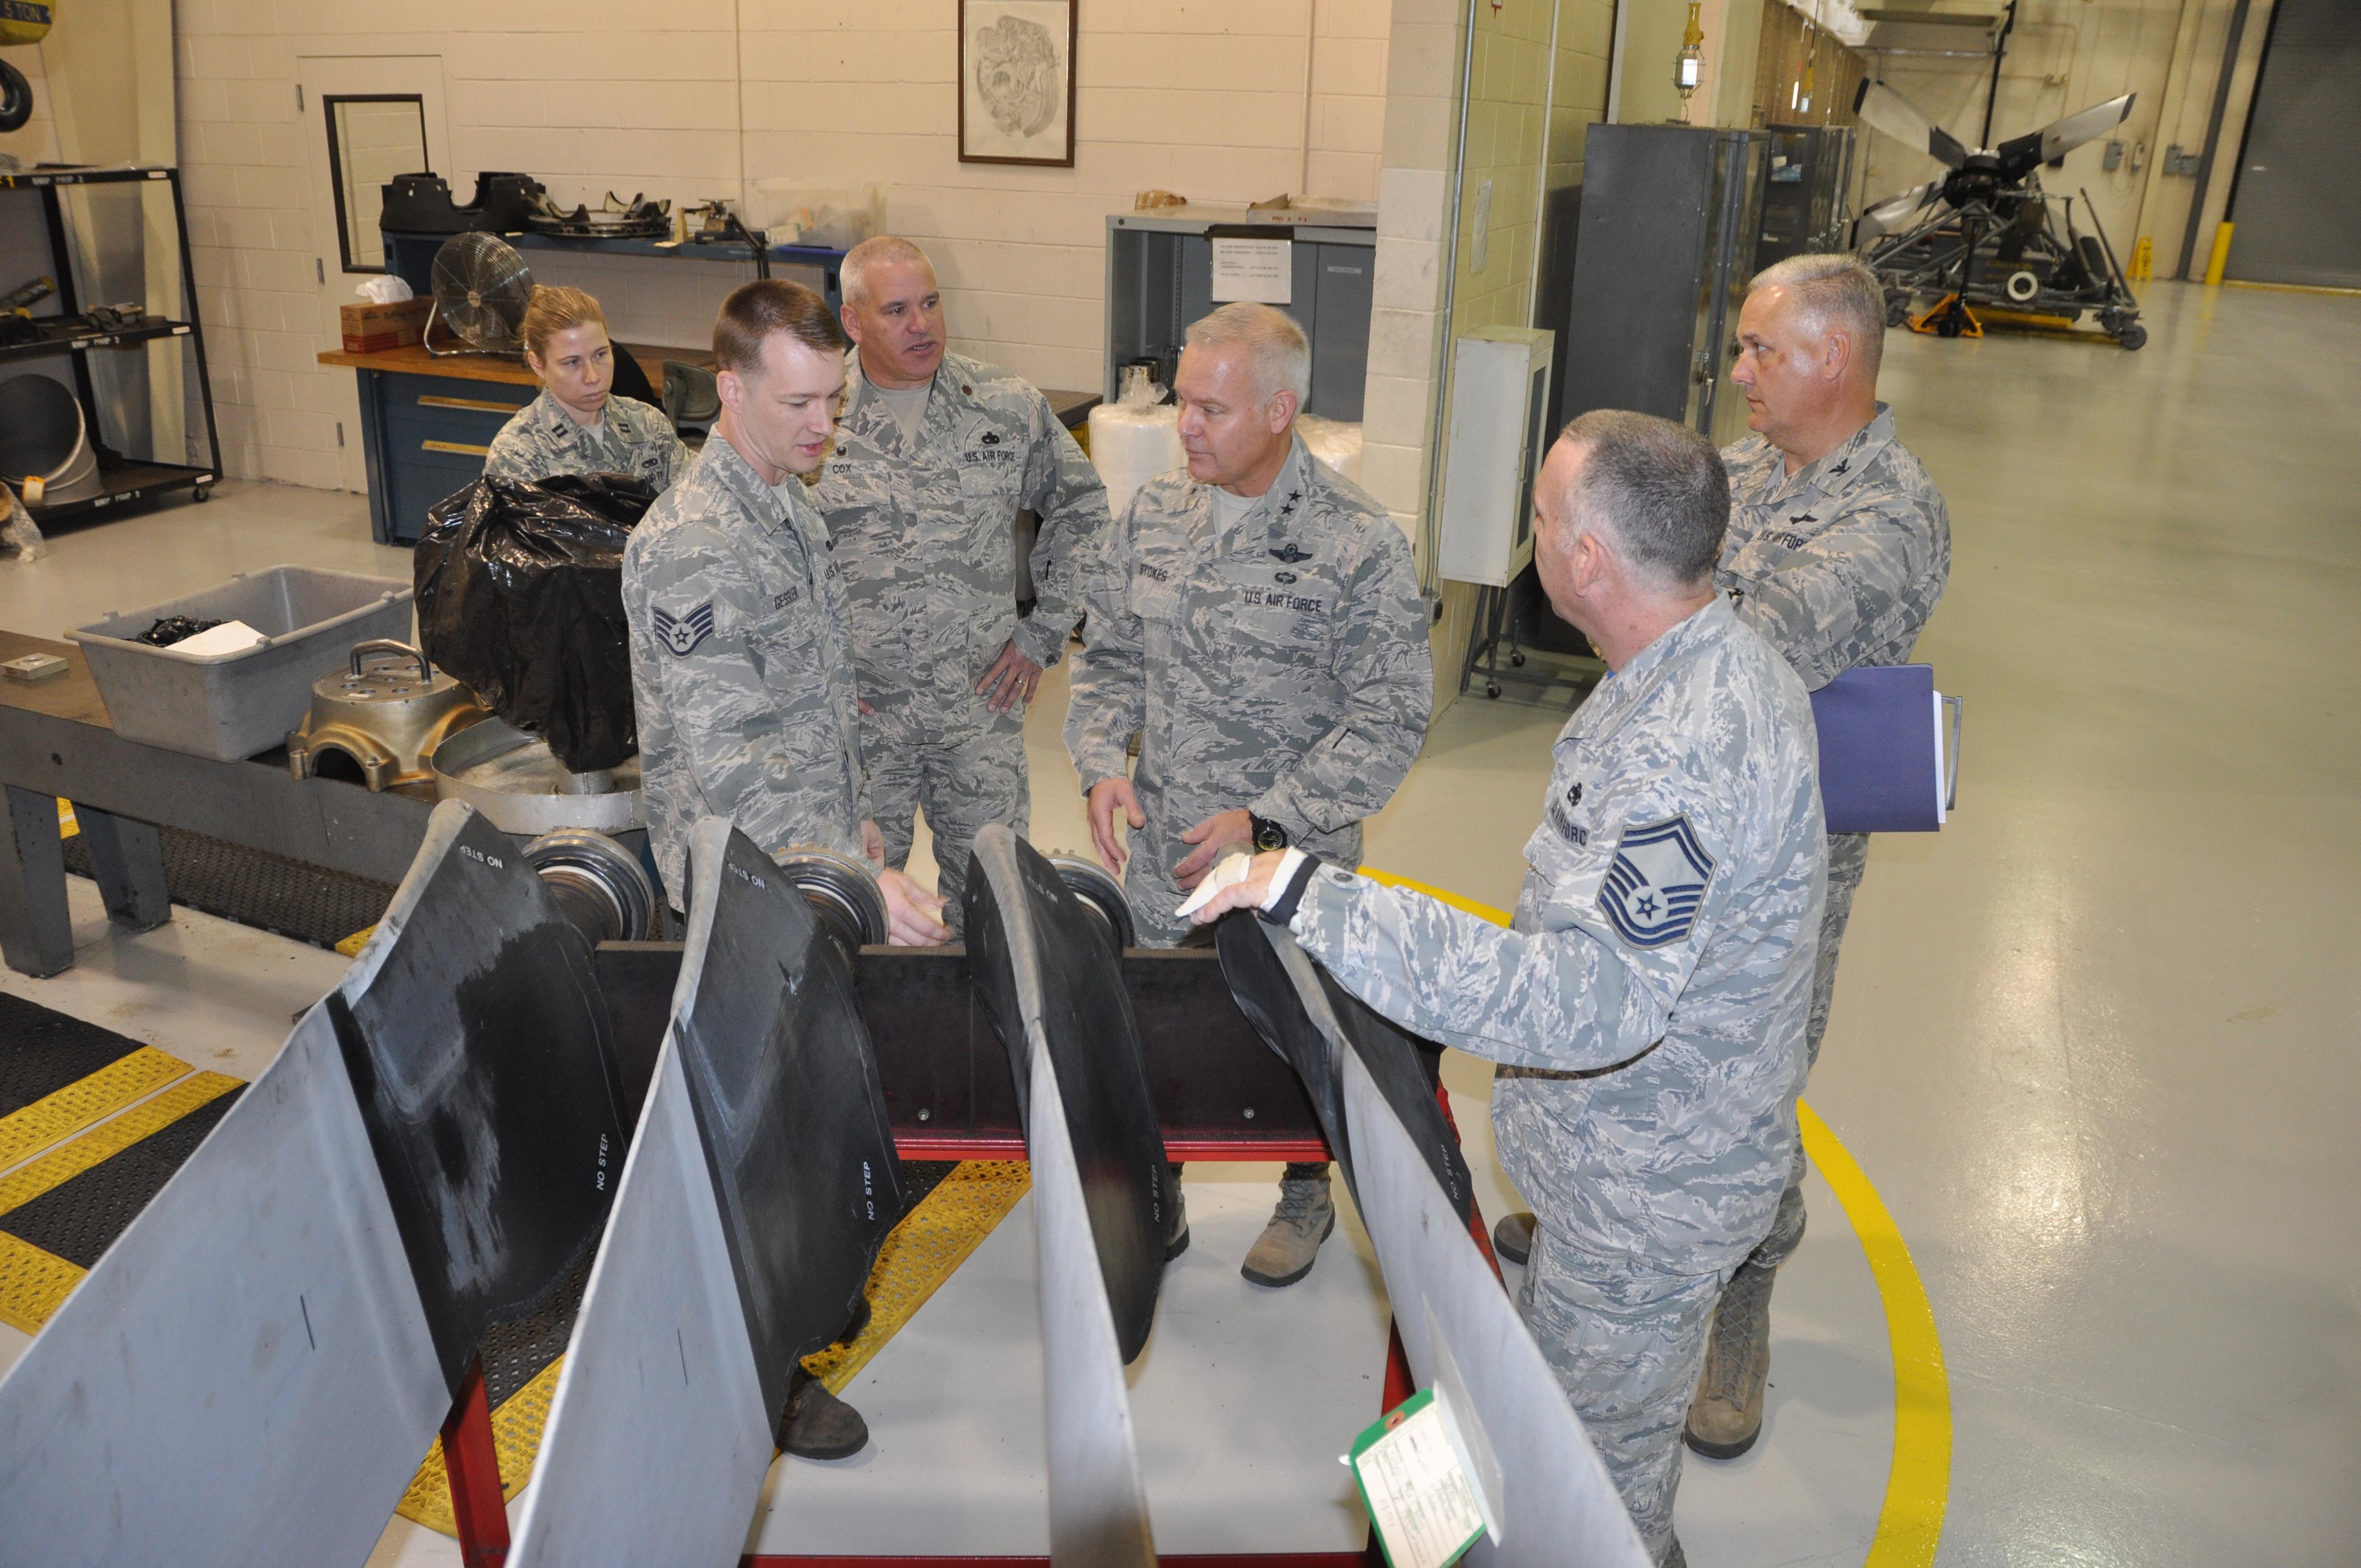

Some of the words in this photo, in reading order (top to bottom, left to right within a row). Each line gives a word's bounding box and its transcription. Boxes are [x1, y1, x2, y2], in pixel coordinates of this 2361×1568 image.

[15, 3, 42, 22] TON
[965, 451, 981, 462] U.S.
[982, 451, 995, 461] AIR
[997, 450, 1015, 462] FORCE
[833, 463, 851, 474] COX
[1781, 533, 1810, 551] FOR
[1140, 563, 1168, 582] STOKES
[1265, 594, 1283, 607] AIR
[1286, 595, 1323, 612] FORCE
[460, 845, 485, 862] STEP
[487, 856, 503, 869] NO
[751, 875, 765, 889] NO
[599, 1134, 608, 1167] STEP
[1441, 1144, 1453, 1177] STEP
[596, 1171, 605, 1191] NO
[863, 1161, 872, 1196] STEP
[1450, 1181, 1459, 1200] NO
[867, 1201, 874, 1221] NO
[1154, 1202, 1160, 1223] NO
